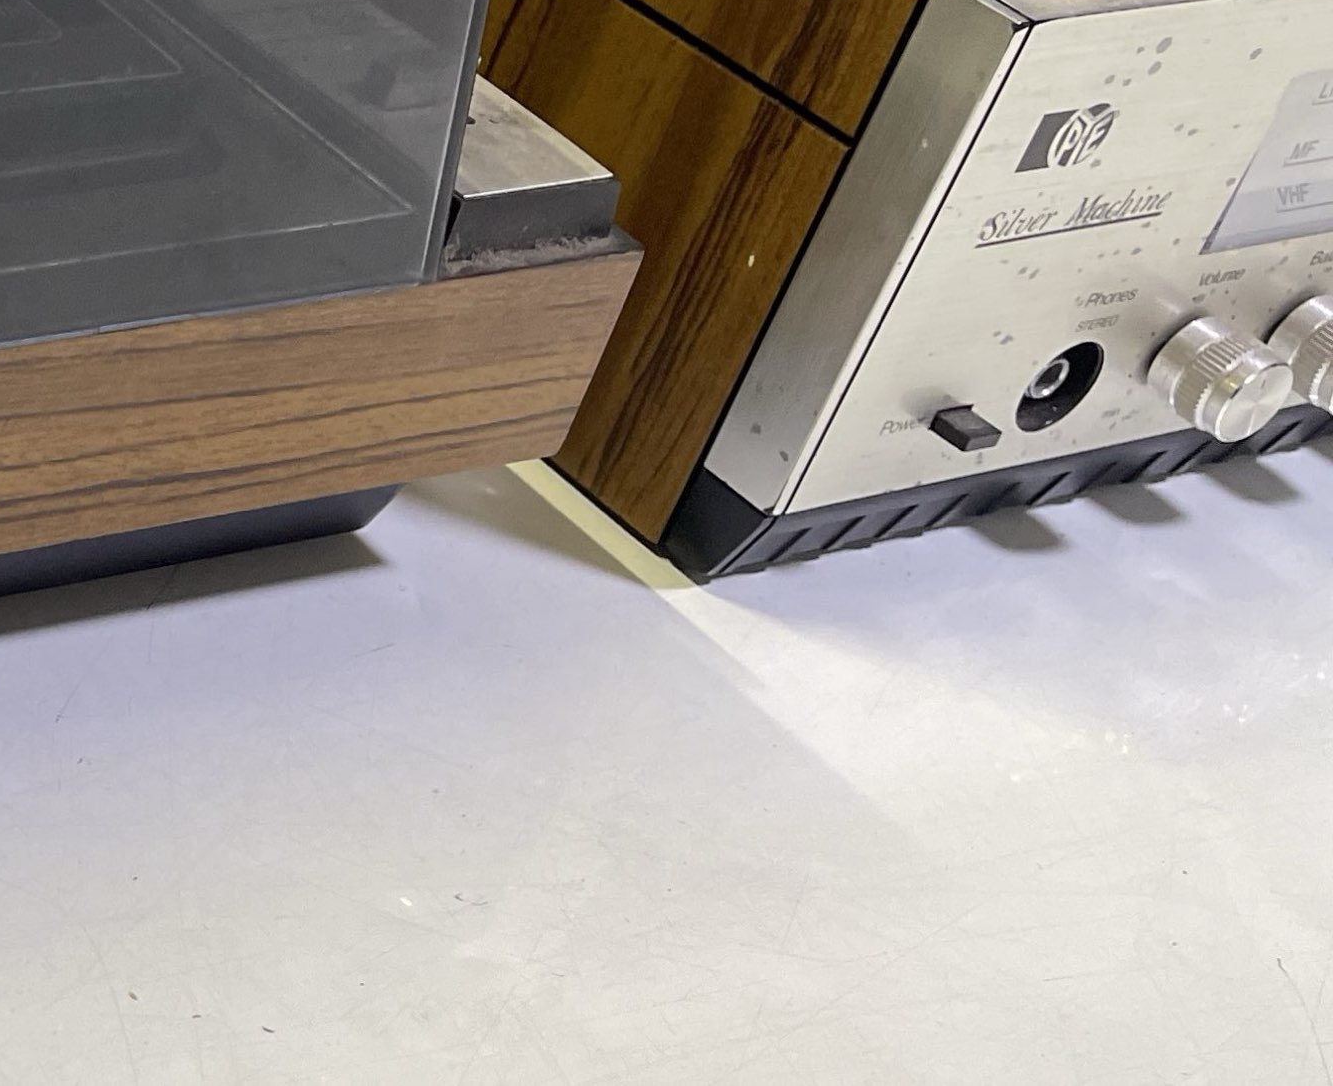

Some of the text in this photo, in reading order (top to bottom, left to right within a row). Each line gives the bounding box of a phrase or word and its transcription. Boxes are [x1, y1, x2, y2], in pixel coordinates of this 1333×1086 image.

[1046, 102, 1120, 167] PYE
[1289, 139, 1320, 161] MF
[1276, 182, 1312, 206] VHF
[978, 188, 1173, 242] Silver Machine
[1198, 268, 1246, 287] Volume
[1084, 288, 1139, 308] Phones
[1074, 314, 1120, 333] STEREO
